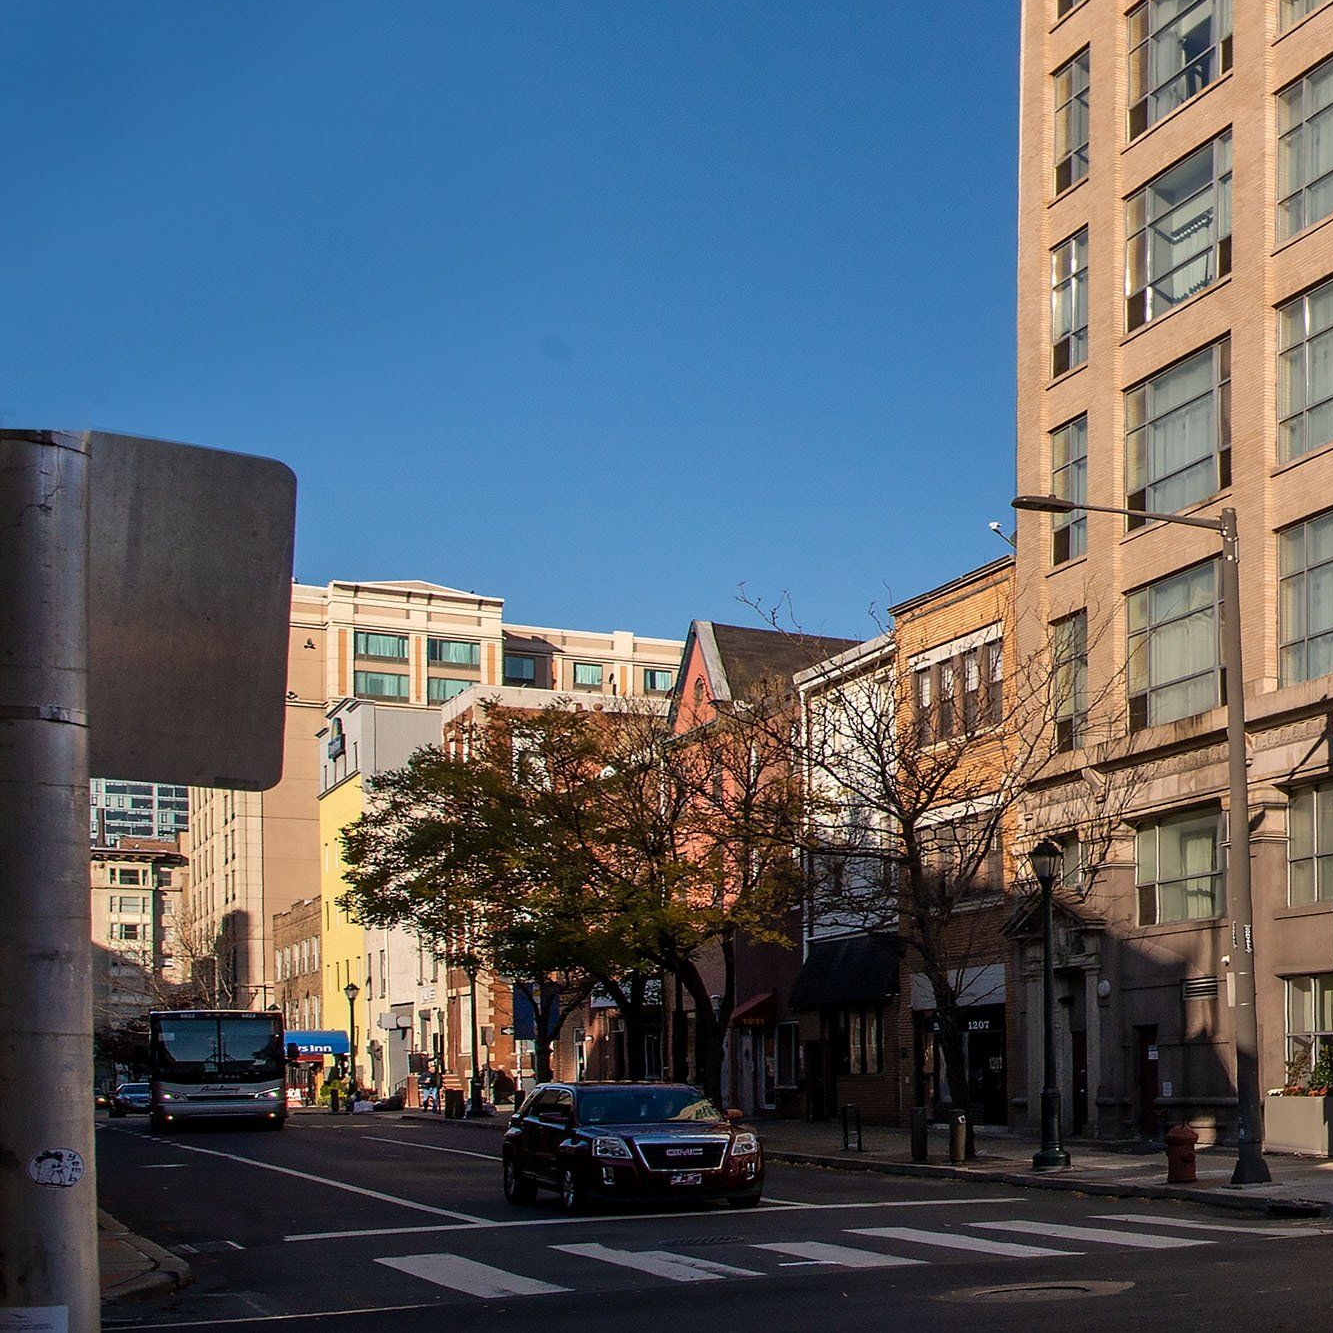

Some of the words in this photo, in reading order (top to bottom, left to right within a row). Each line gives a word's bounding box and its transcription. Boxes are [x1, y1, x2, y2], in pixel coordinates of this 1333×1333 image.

[967, 1020, 990, 1030] 1207
[309, 1044, 332, 1052] Inn
[666, 1148, 703, 1156] GMC
